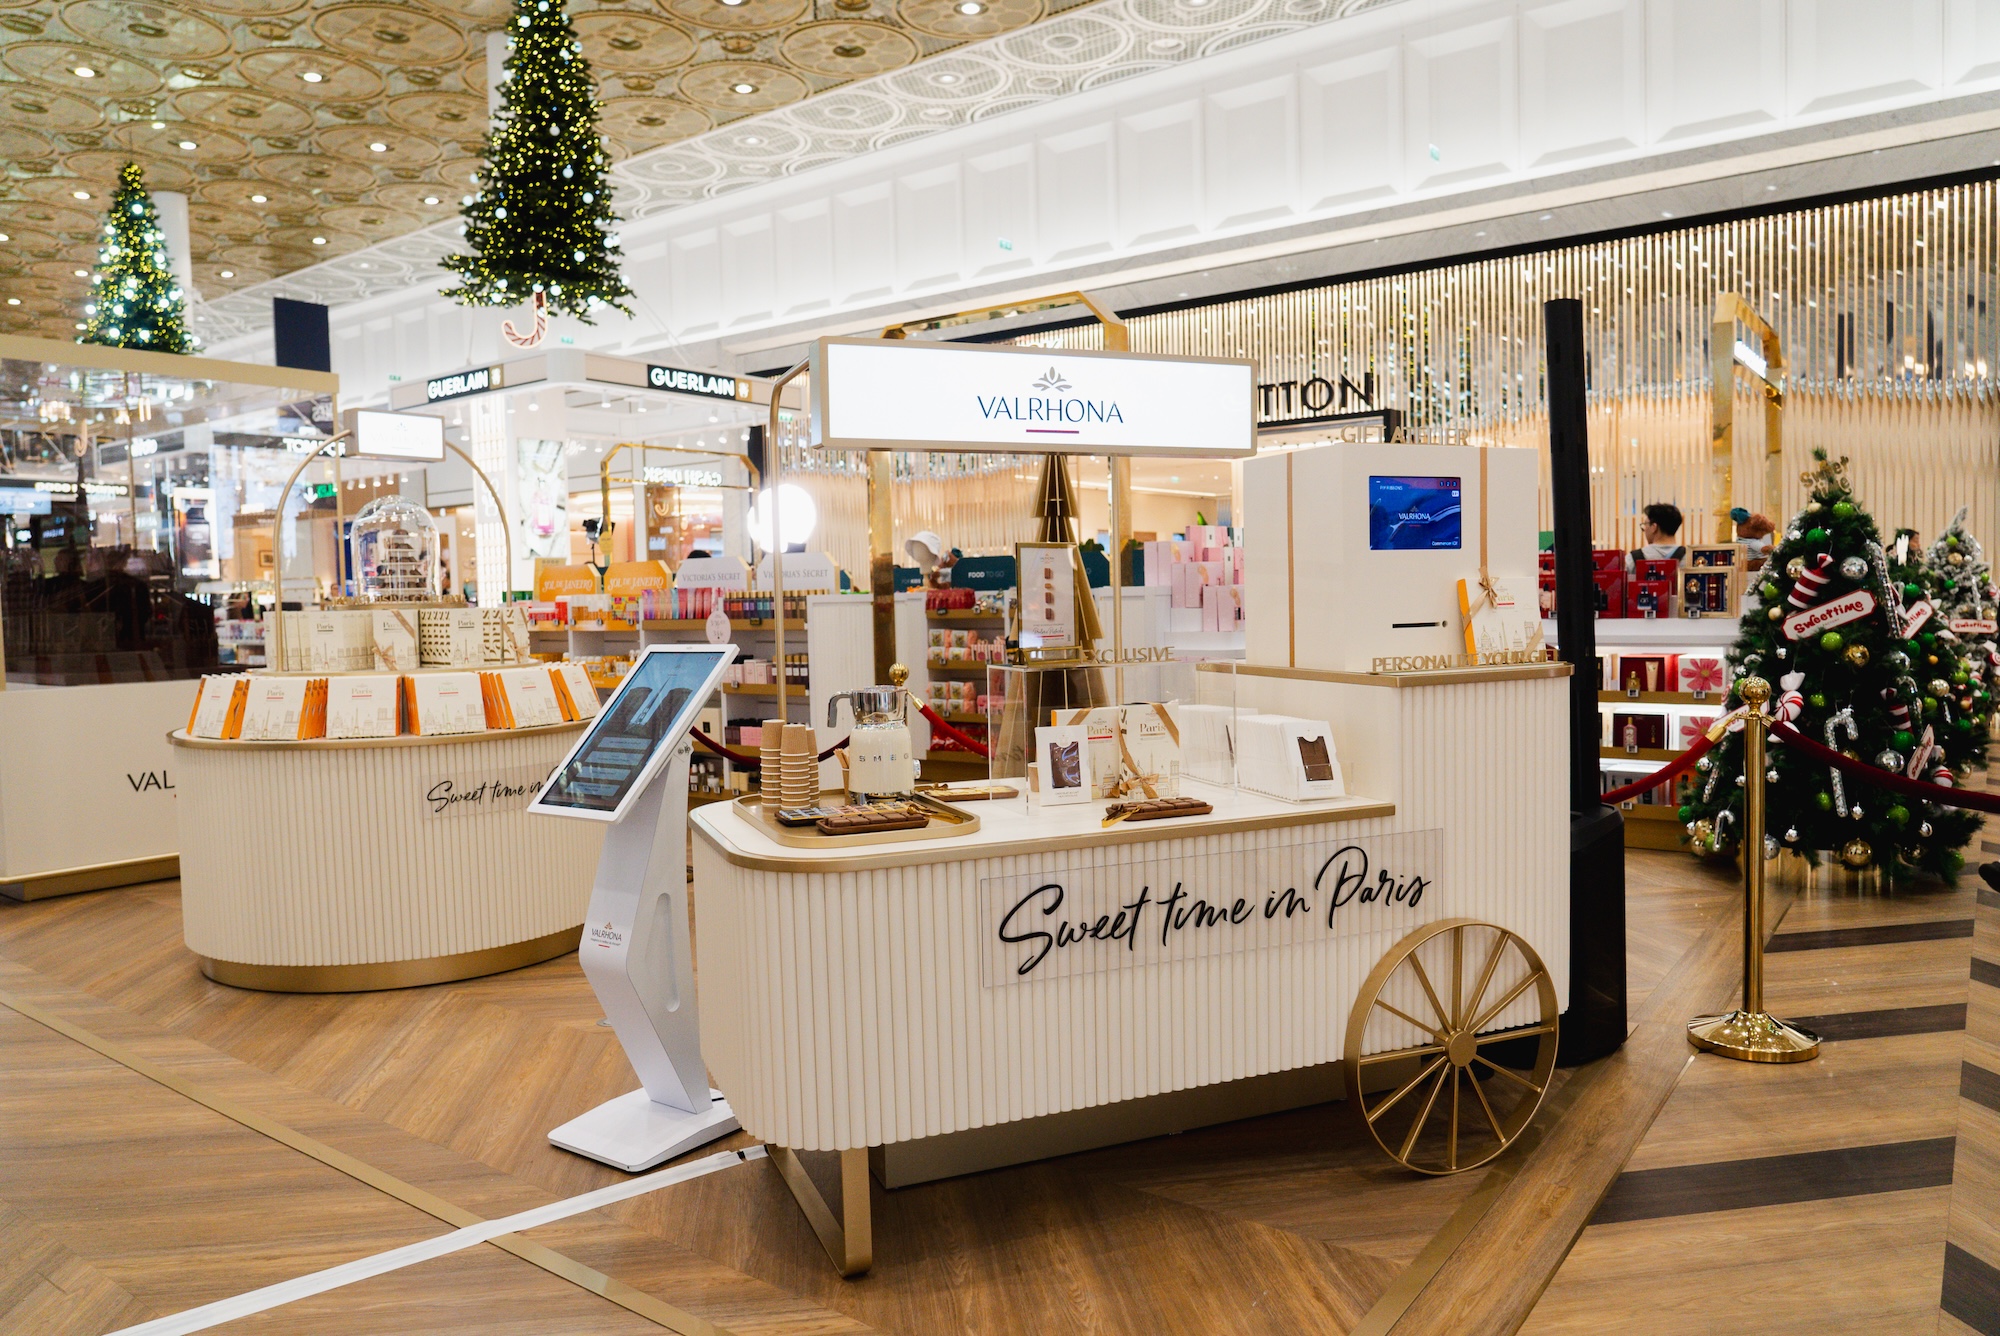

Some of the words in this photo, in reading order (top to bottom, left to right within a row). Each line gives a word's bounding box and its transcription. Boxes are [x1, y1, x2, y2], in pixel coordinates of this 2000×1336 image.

[428, 370, 488, 399] GUERLAIN
[650, 368, 735, 397] GUERLAIN
[977, 396, 1124, 423] VALRHONA
[1341, 425, 1386, 443] GIFT
[1391, 426, 1469, 446] ATELIER
[1398, 512, 1431, 520] VALRHONA
[682, 572, 716, 582] VICTORIA'S
[717, 571, 741, 581] SECRET
[802, 569, 829, 577] SECRET
[542, 580, 556, 592] SOL
[563, 578, 594, 592] JANEIRO
[608, 577, 622, 591] SOL
[630, 576, 664, 590] JANEIRO
[1497, 593, 1515, 602] aris
[1081, 646, 1175, 664] EXCLUSIVE
[1373, 653, 1480, 674] PERSONALIZE
[1482, 650, 1524, 665] YOUR
[266, 689, 285, 697] Paris
[351, 687, 373, 695] Paris
[1087, 725, 1113, 735] Paris
[1140, 723, 1166, 733] Paris
[427, 780, 487, 813] Sweet
[490, 780, 527, 803] time
[999, 884, 1152, 975] Sweet
[1156, 881, 1256, 946] time
[1264, 886, 1311, 919] in
[1315, 845, 1432, 929] Paris
[591, 928, 622, 941] VALRHONA
